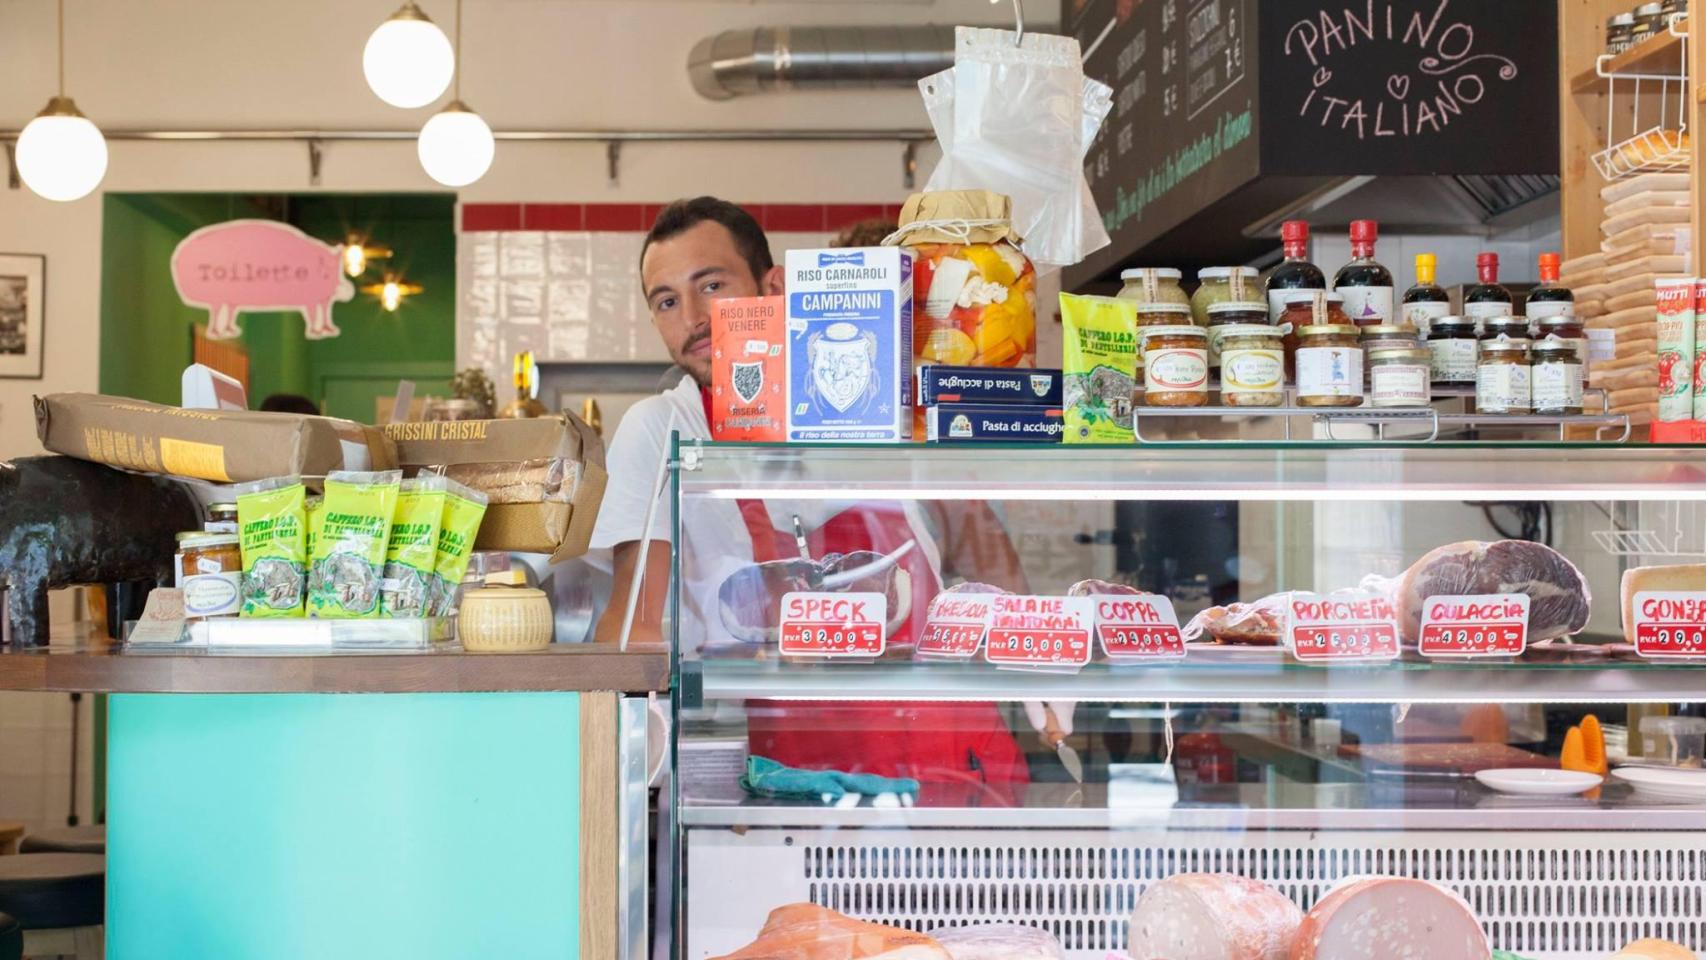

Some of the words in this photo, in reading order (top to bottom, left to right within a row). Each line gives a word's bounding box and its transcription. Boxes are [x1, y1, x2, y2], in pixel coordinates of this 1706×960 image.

[1284, 0, 1474, 66] PANINO
[1300, 74, 1484, 140] ITALIANO
[198, 263, 309, 282] Toilette
[796, 269, 822, 282] RISO
[825, 267, 887, 281] CARNAROLI
[802, 292, 881, 311] CAMPANINI
[1656, 288, 1688, 300] MUTTI
[720, 307, 744, 320] RISO
[747, 306, 774, 318] NERO
[728, 320, 767, 332] VENERE
[938, 376, 982, 389] acciughe
[984, 379, 994, 390] di
[996, 380, 1021, 391] Pasta
[384, 423, 437, 440] GRISSINI
[440, 421, 487, 439] CRISTAL
[982, 420, 1009, 432] Pasta
[1010, 421, 1021, 431] di
[787, 599, 866, 622] SPECK
[1099, 601, 1160, 623] COPPA
[802, 629, 856, 646] 32,00
[1008, 636, 1062, 654] 23,00
[1441, 631, 1497, 647] 42,00
